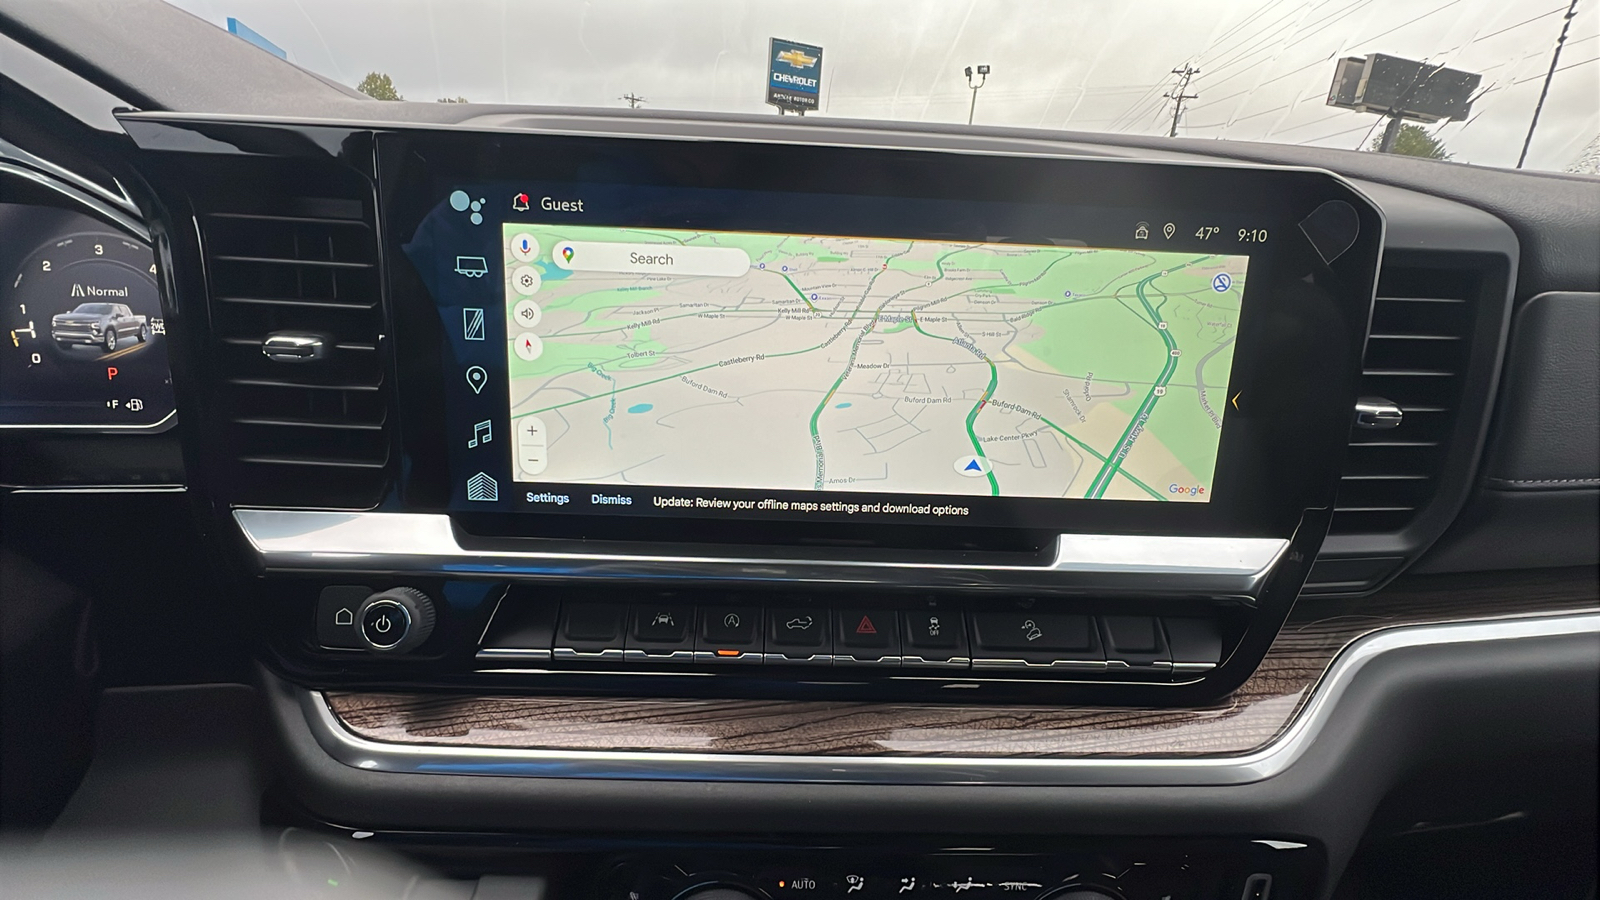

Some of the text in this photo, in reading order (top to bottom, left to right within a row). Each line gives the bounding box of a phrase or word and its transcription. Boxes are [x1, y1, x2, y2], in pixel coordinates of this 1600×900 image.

[773, 73, 817, 87] CHEVROLET
[541, 197, 584, 212] Guest
[1237, 229, 1268, 243] 9:10
[94, 244, 103, 255] 3
[629, 252, 674, 266] Search
[42, 261, 51, 272] 2
[149, 264, 157, 274] 4
[87, 286, 128, 297] Normal
[20, 304, 26, 314] 1
[914, 303, 931, 311] Pilgrim
[820, 319, 853, 349] Castleberry Rd
[31, 353, 42, 364] 0
[627, 351, 648, 359] Tolbert
[718, 355, 755, 367] Castleberry
[107, 367, 119, 380] P
[587, 361, 612, 381] Big Creek
[681, 375, 728, 399] Buford Dam Rd
[112, 400, 119, 409] F
[1062, 388, 1086, 423] Shamrock Dr
[1200, 390, 1211, 412] Market
[992, 399, 1042, 420] Buford Dam Rd
[603, 414, 614, 423] Big
[1020, 430, 1038, 439] Pkwy
[1129, 424, 1145, 443] Hwy
[1169, 483, 1205, 496] Google
[526, 492, 570, 505] Settings
[591, 494, 632, 505] Dismiss
[653, 496, 969, 517] Update: Review your offline maps settings and download options
[791, 880, 816, 890] AUTO
